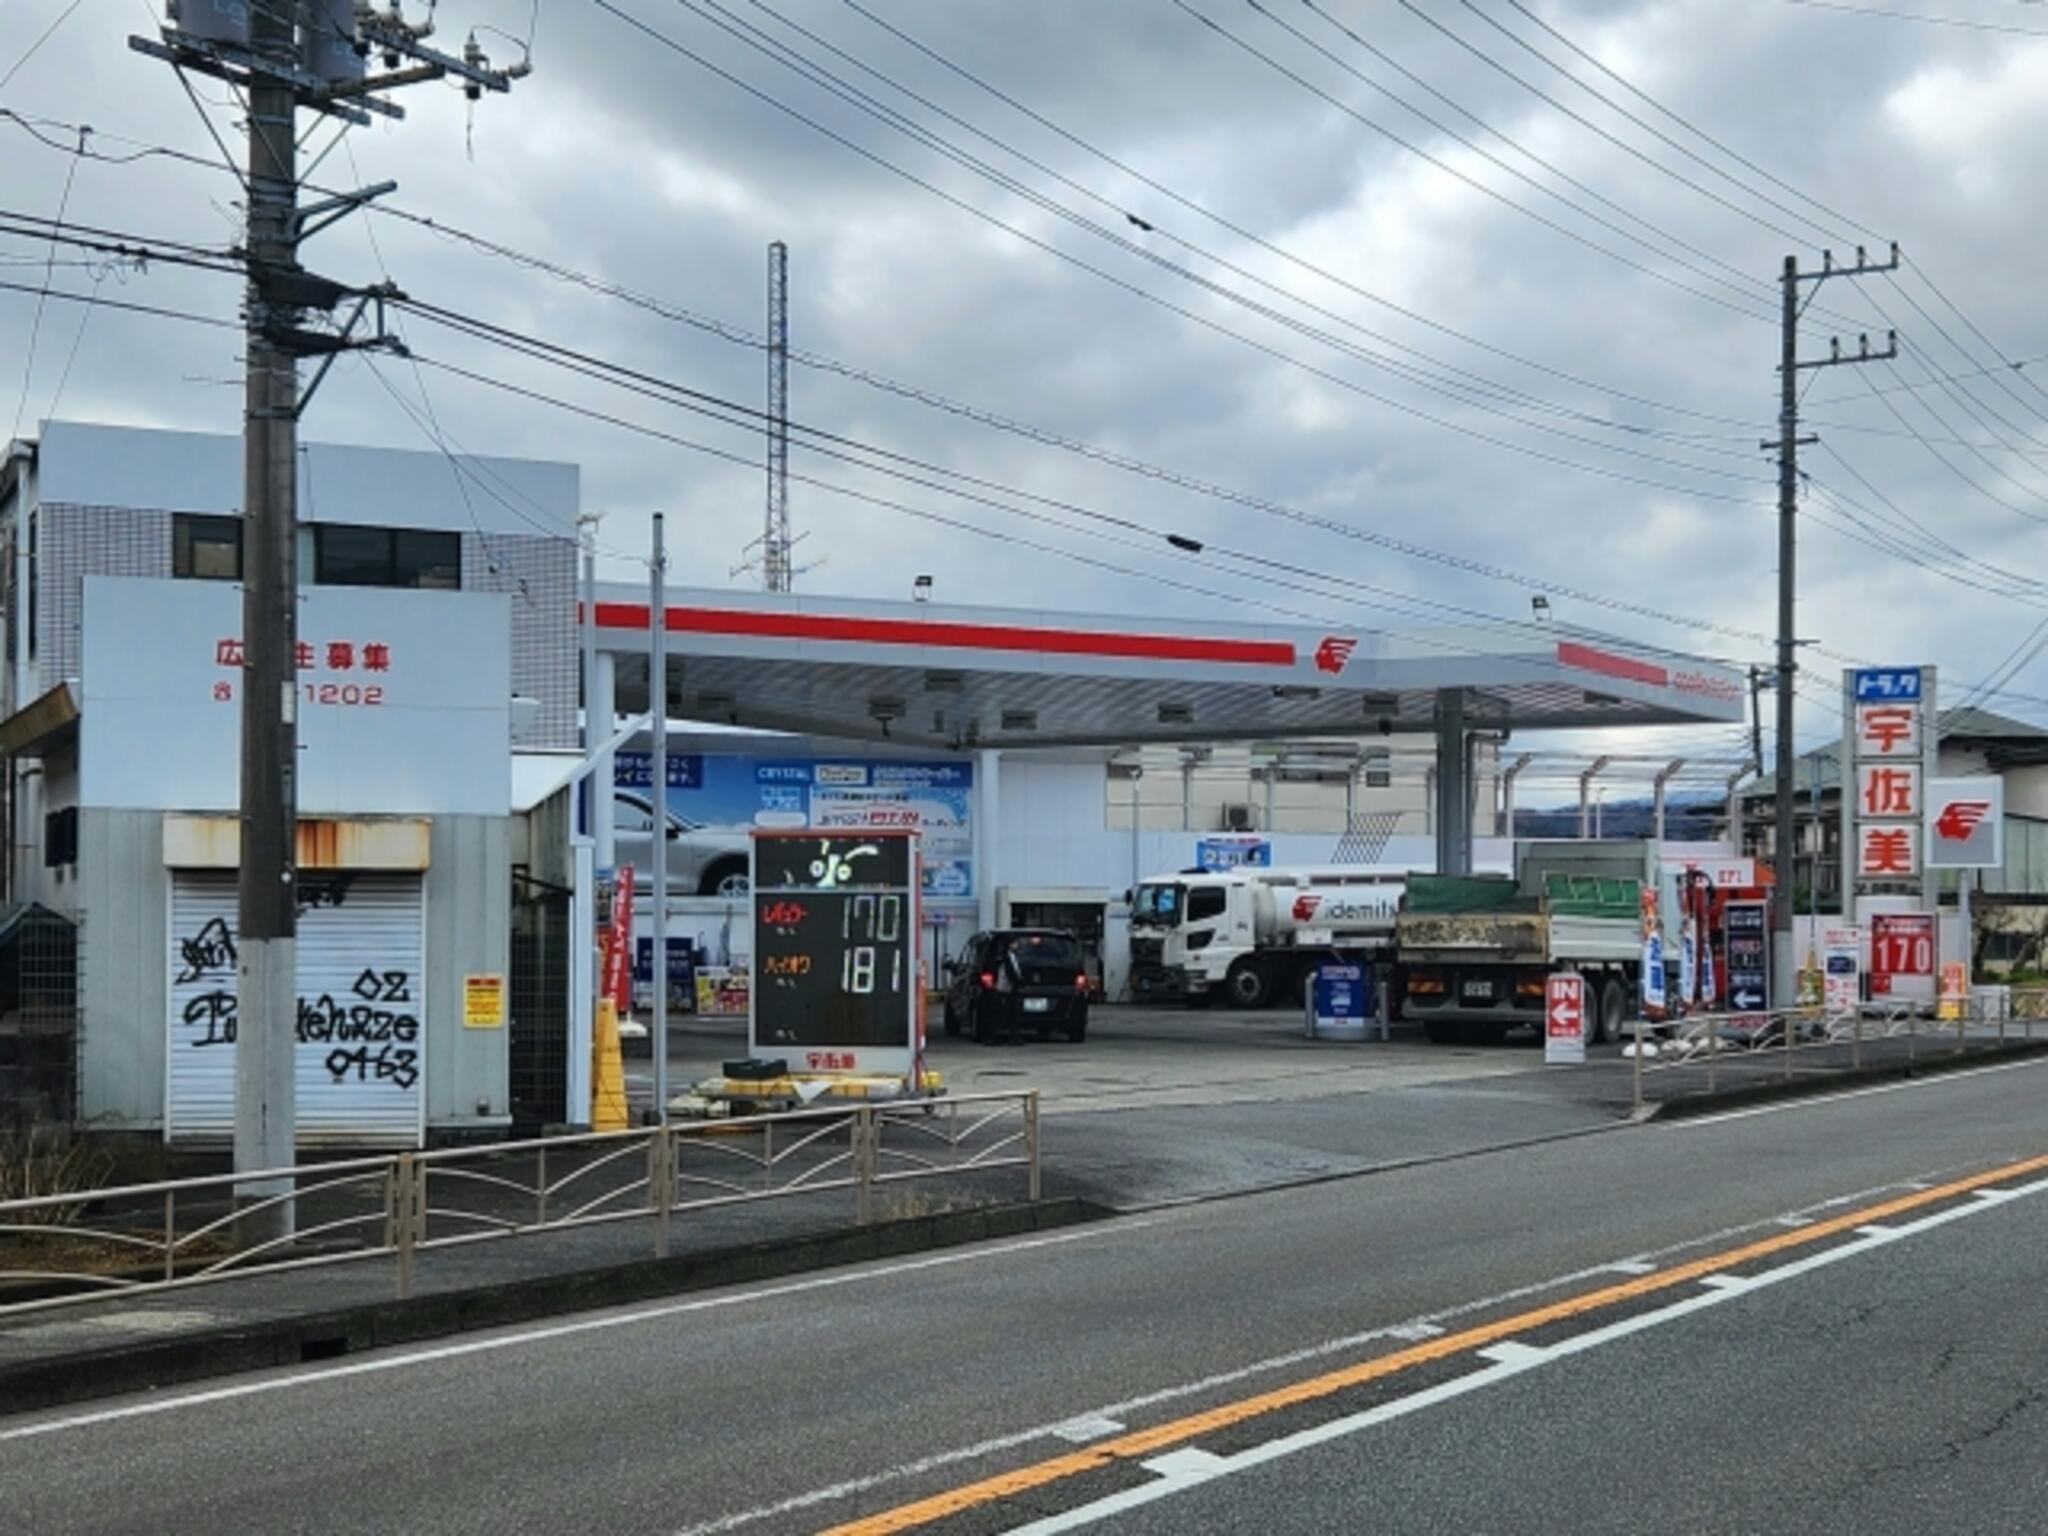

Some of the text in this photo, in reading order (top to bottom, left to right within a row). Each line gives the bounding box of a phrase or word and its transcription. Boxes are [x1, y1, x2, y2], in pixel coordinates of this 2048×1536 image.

[215, 639, 390, 672] 広主募集
[843, 895, 900, 941] 170
[842, 947, 900, 993] 181
[1877, 936, 1932, 972] 170
[1551, 981, 1578, 999] IN
